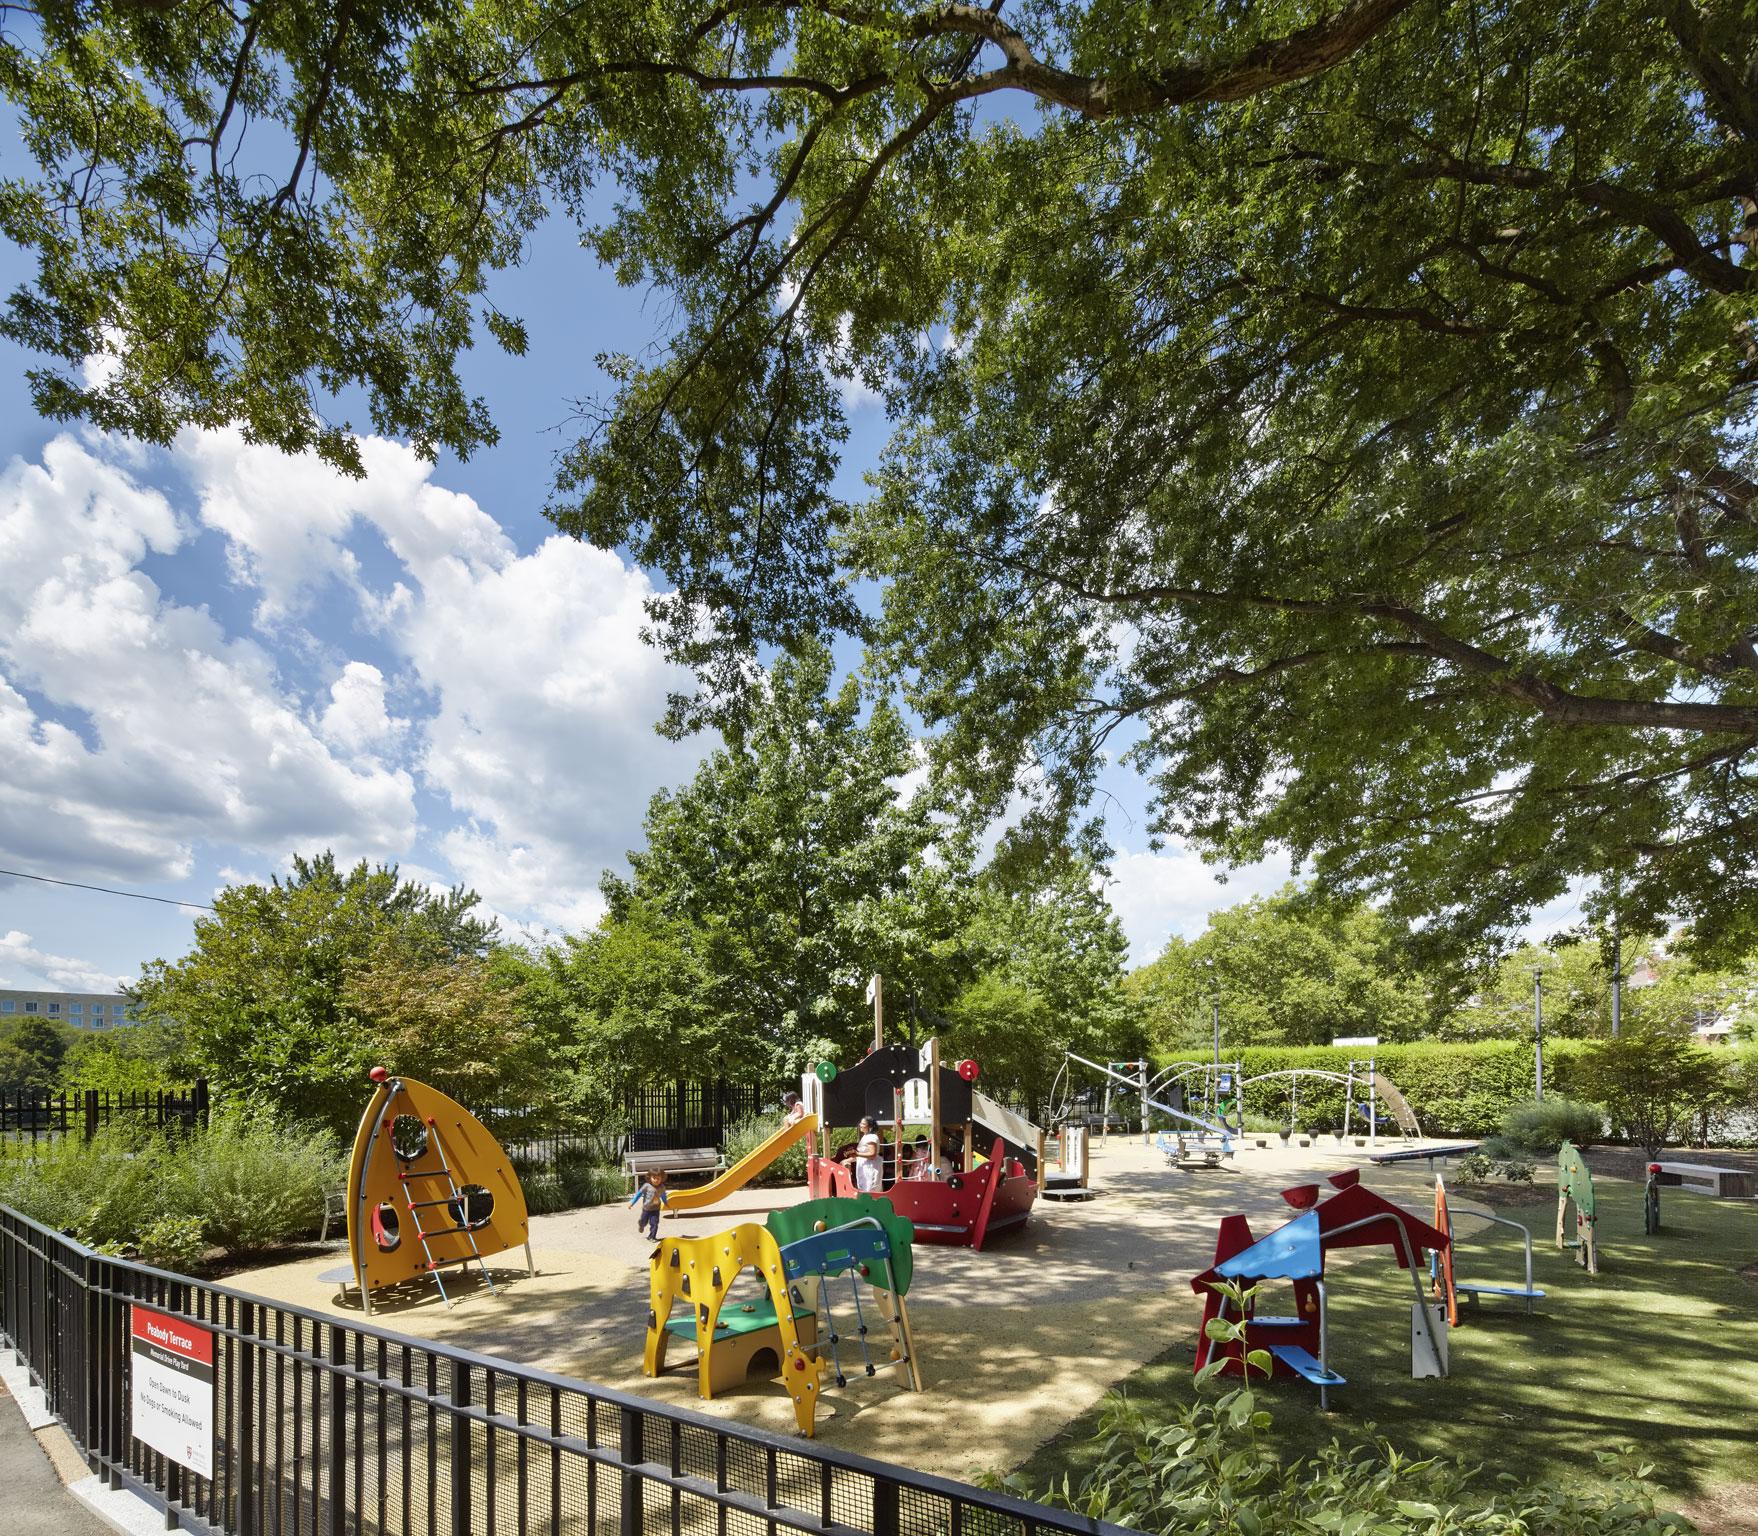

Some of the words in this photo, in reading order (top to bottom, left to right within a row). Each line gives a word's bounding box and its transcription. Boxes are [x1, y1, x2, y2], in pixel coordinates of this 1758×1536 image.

[1438, 1306, 1445, 1322] 1
[147, 1321, 169, 1344] Peabody
[169, 1330, 192, 1350] Terrace
[149, 1376, 159, 1391] Open
[159, 1382, 171, 1397] Dawn
[172, 1389, 177, 1399] to
[178, 1390, 190, 1404] Dusk
[140, 1391, 146, 1403] No
[146, 1394, 156, 1410] Dogs
[161, 1403, 181, 1423] Smoking
[181, 1413, 203, 1430] Allowed
